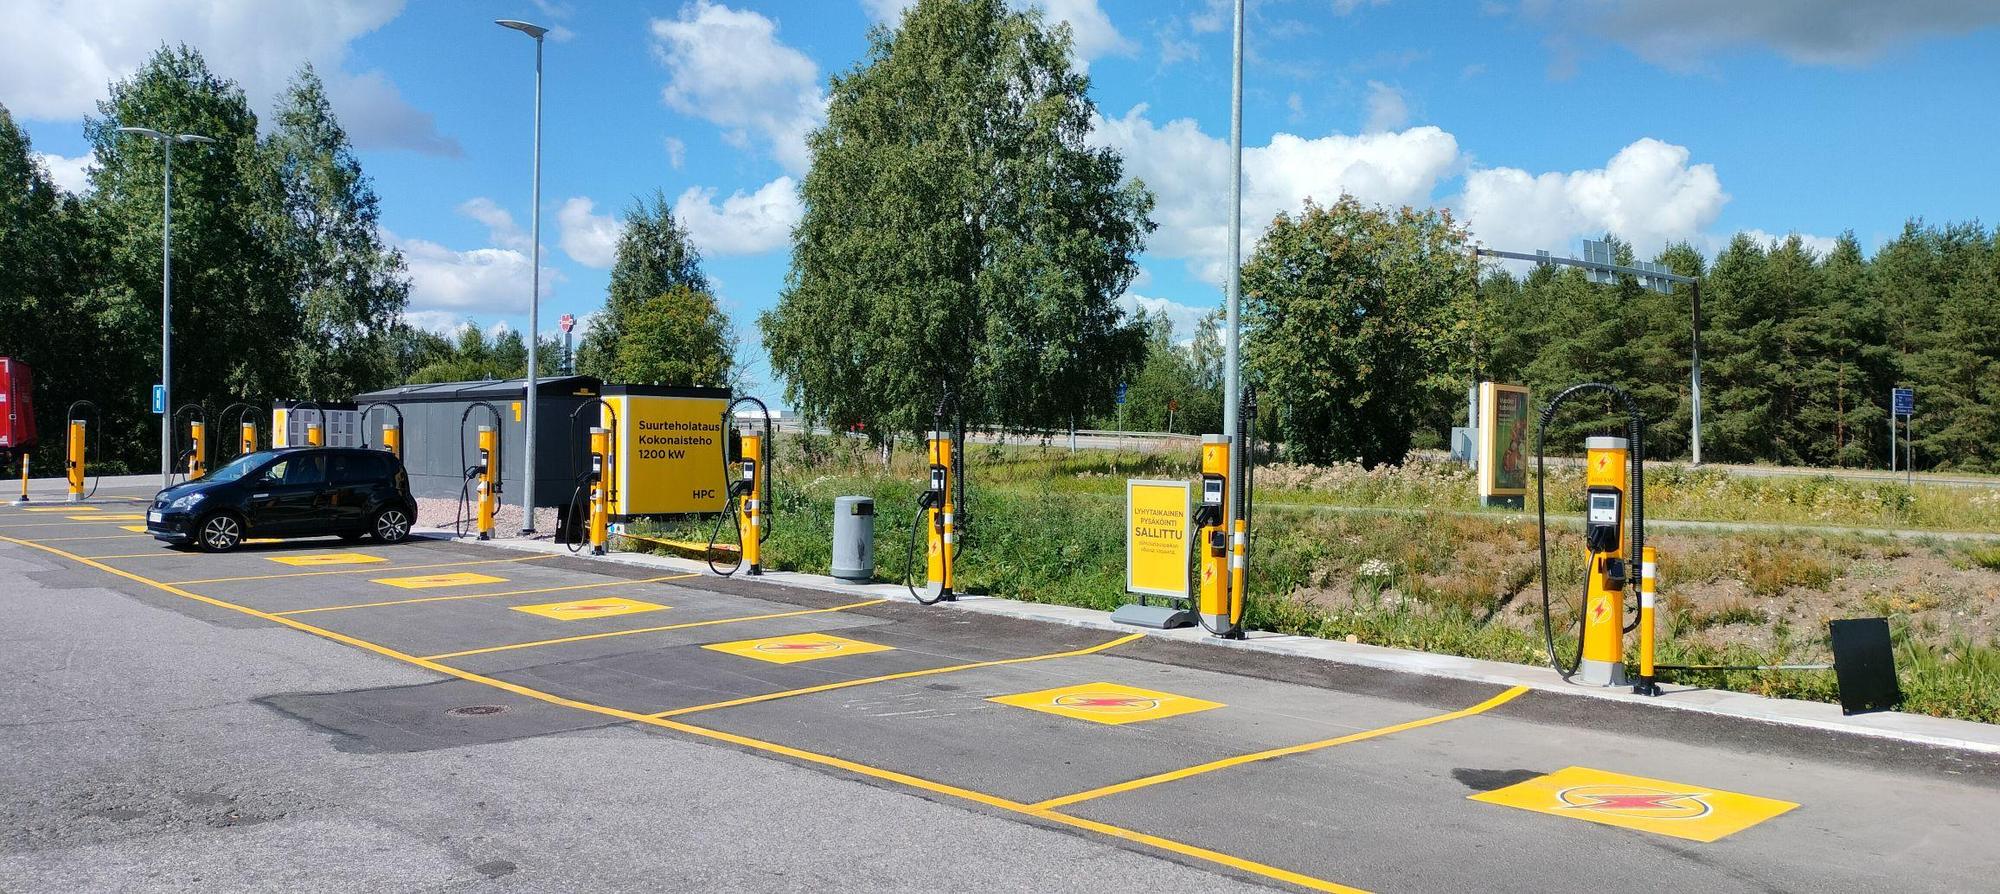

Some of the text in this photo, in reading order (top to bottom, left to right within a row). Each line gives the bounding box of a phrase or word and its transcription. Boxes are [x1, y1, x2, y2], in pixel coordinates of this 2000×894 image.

[638, 420, 720, 432] Suurteholataus
[638, 434, 713, 446] Kokonaisteho
[638, 449, 686, 459] 1200 kW
[692, 489, 716, 499] HPC
[1134, 508, 1184, 518] LYHYTAIKAINEN
[1135, 526, 1183, 540] SALLITTU
